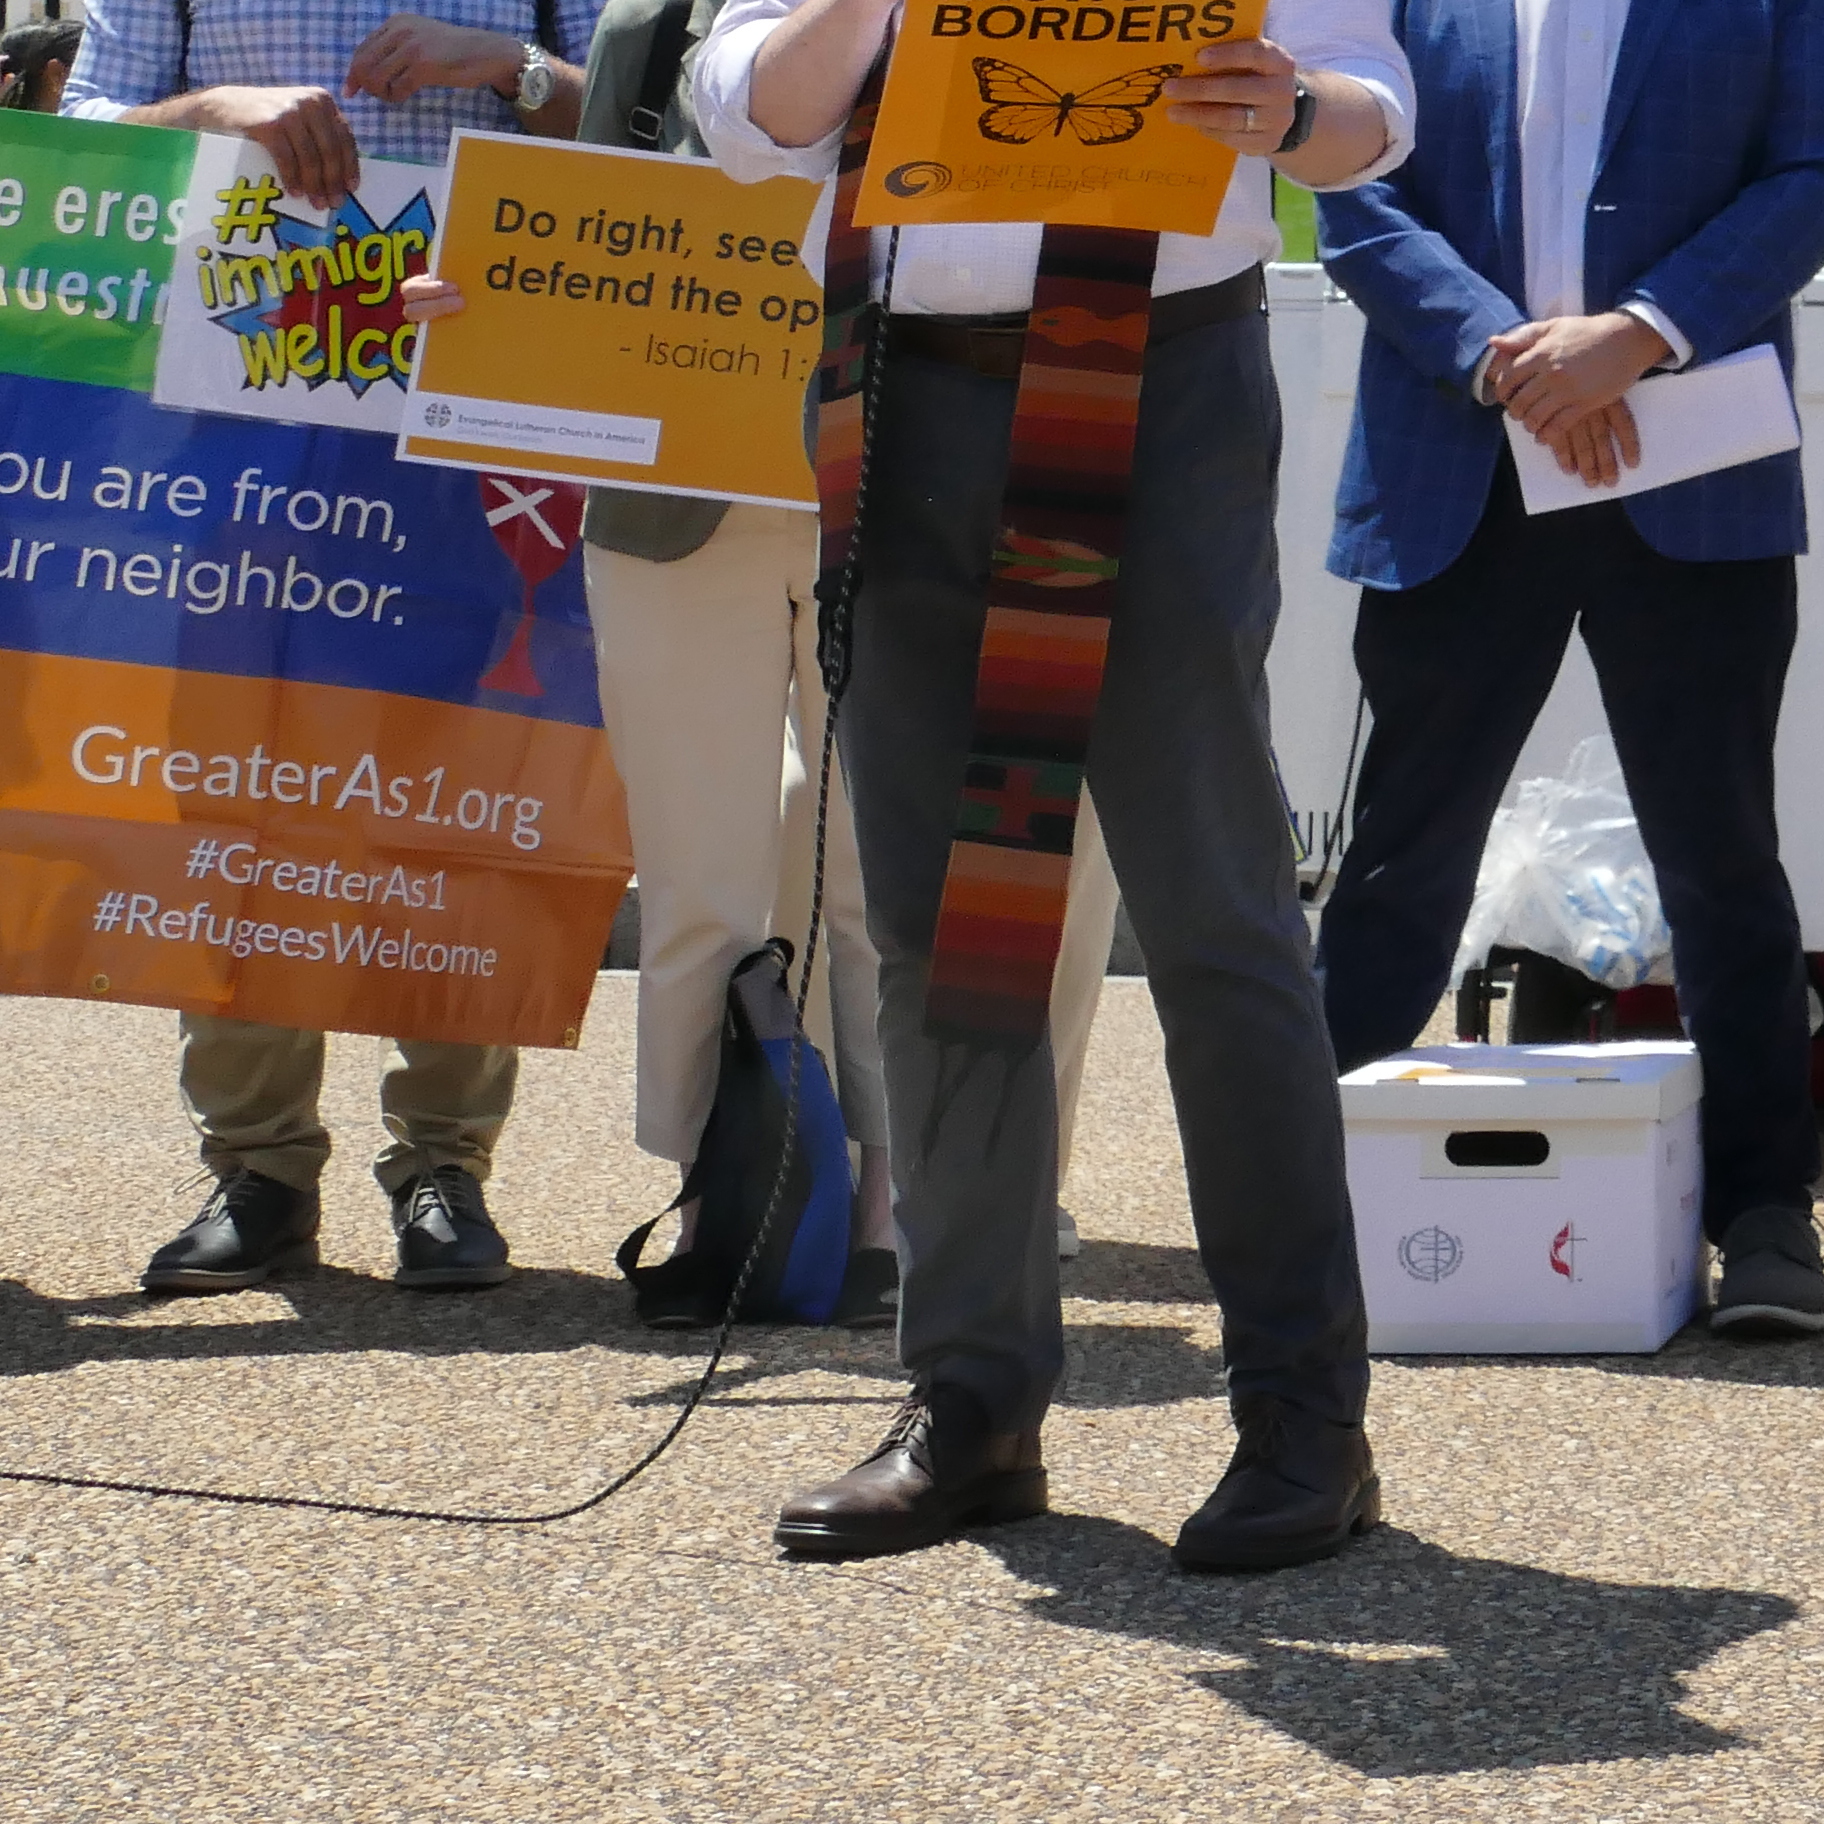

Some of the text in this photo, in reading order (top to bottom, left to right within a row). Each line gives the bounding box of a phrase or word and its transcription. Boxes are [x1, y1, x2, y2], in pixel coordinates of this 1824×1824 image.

[930, 0, 1237, 43] BORDERS
[960, 164, 1071, 178] UNITED
[1009, 179, 1114, 195] CHRIST
[54, 185, 189, 245] eres
[494, 197, 806, 270] Do right, see
[196, 224, 434, 310] immigr
[485, 254, 655, 308] defend
[670, 274, 743, 317] the
[645, 333, 760, 377] Isaiah
[92, 465, 207, 518] are
[232, 467, 407, 552] from,
[75, 543, 404, 626] neighbor.
[70, 725, 544, 851] GreaterAs1.org
[185, 838, 446, 912] #GreaterAs1
[93, 890, 498, 978] #RefugeesWelcome
